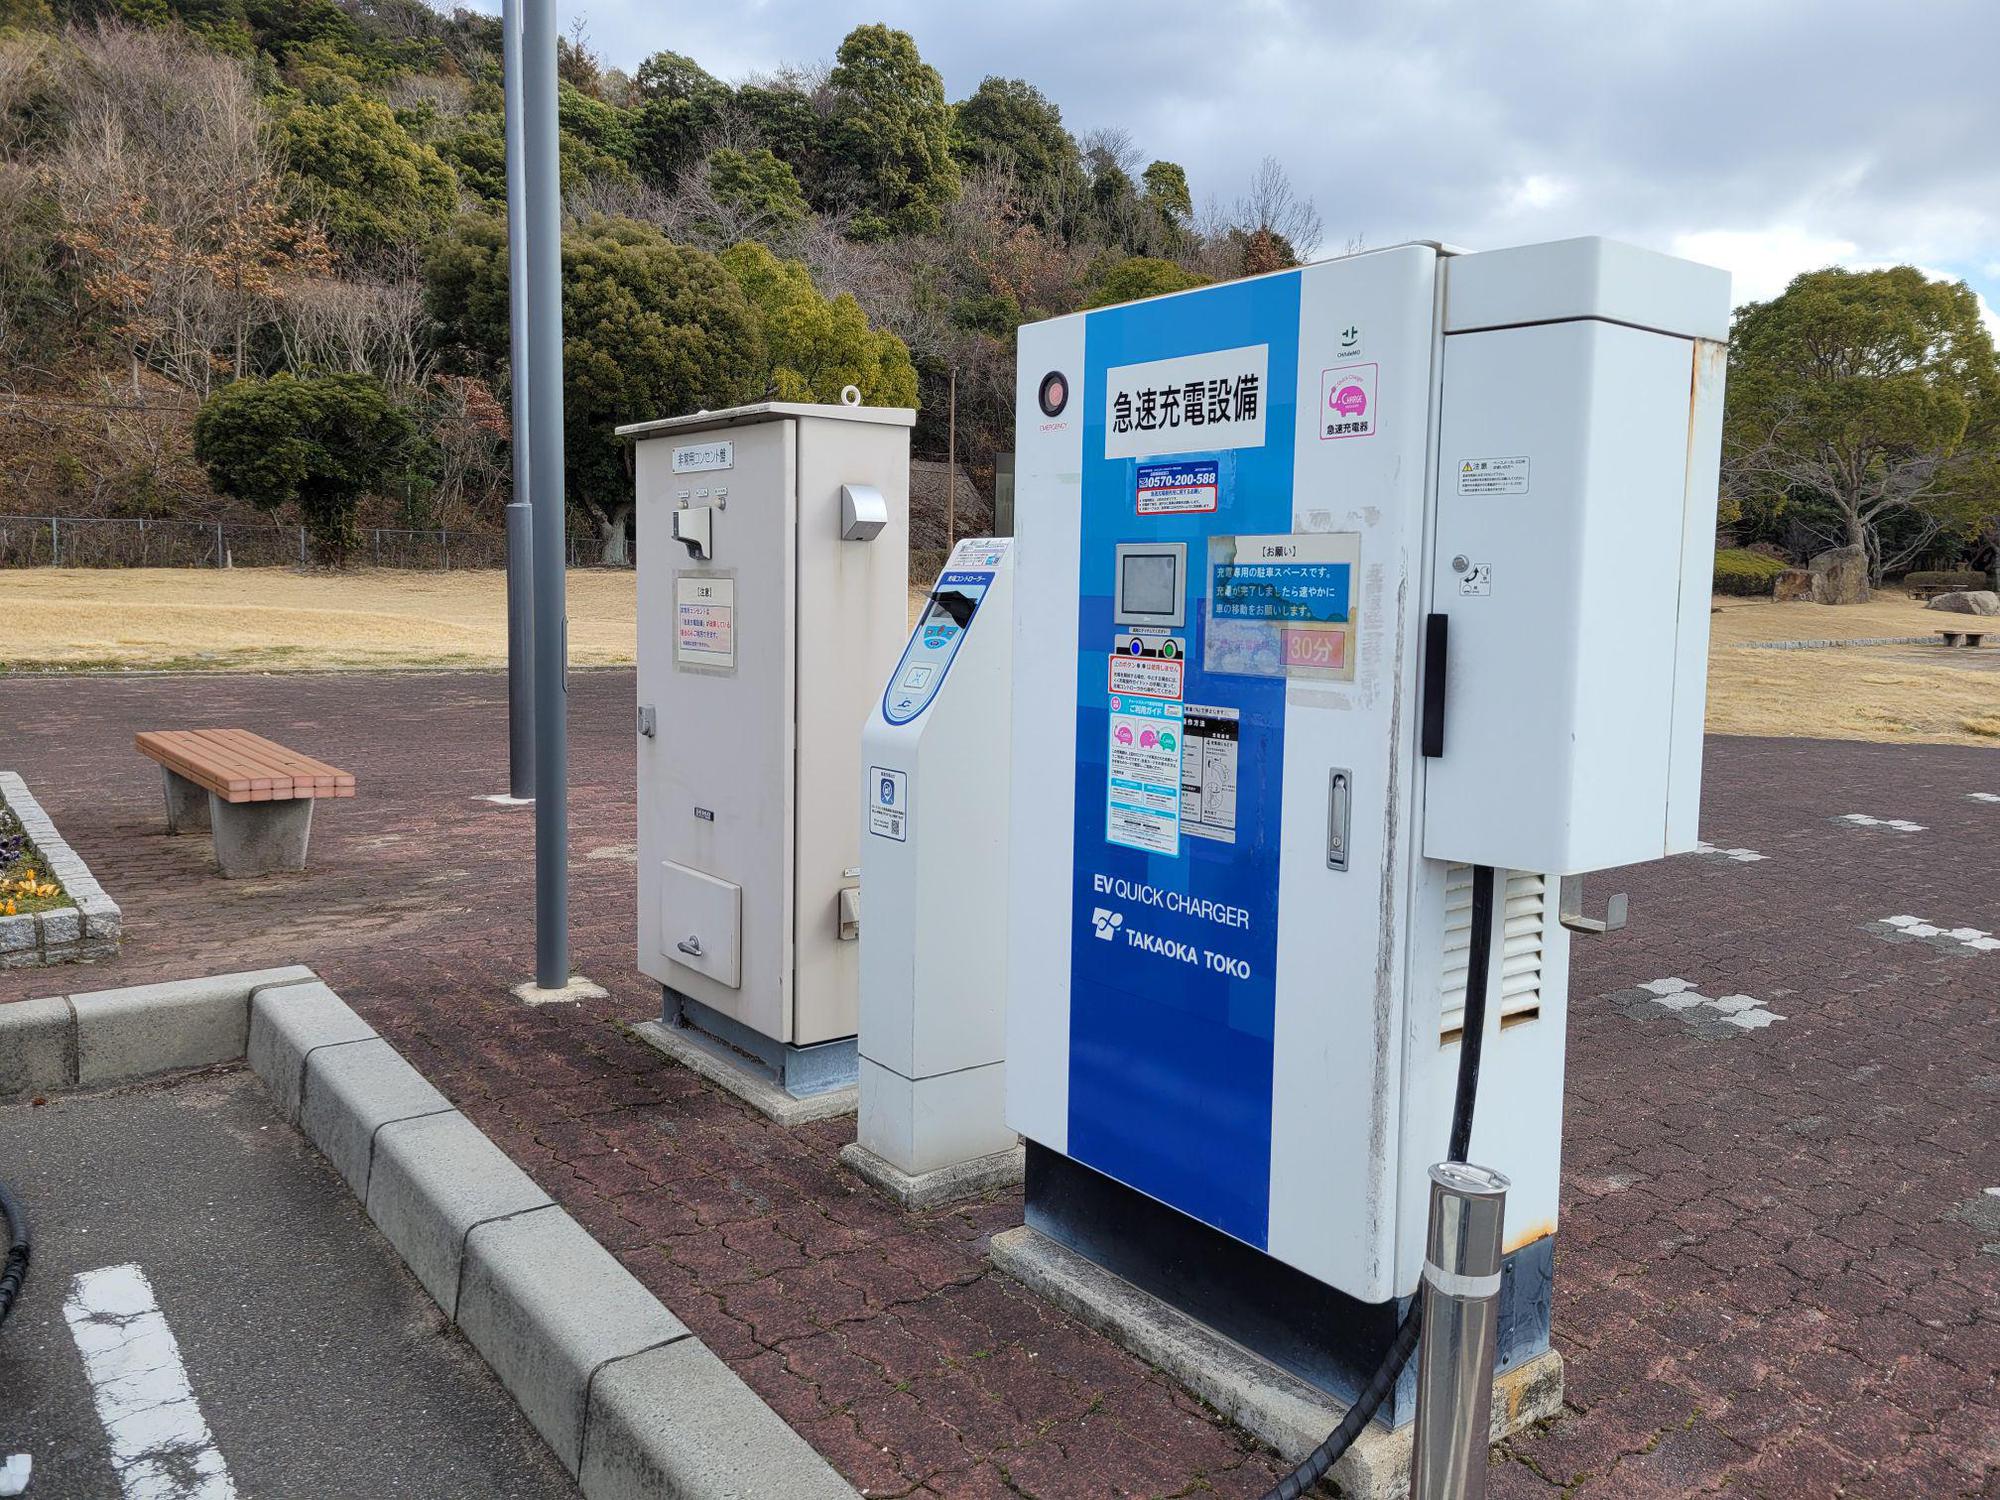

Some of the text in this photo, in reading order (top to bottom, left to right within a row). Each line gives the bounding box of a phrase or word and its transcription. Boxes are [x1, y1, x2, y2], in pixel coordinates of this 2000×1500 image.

[1113, 374, 1258, 433] 急速充電設備
[1327, 421, 1368, 435] 急速充電器
[1148, 473, 1216, 488] 0570-200-588
[1262, 545, 1297, 557] 【お願い】
[1215, 586, 1336, 598] 充電が完了しましたら速やかに
[1215, 604, 1312, 617] 車の移動をお願いします。
[1290, 636, 1333, 662] 30分
[1094, 873, 1249, 930] EV QUICK CHARGER
[1126, 929, 1250, 980] TAKAOKA TOKO
